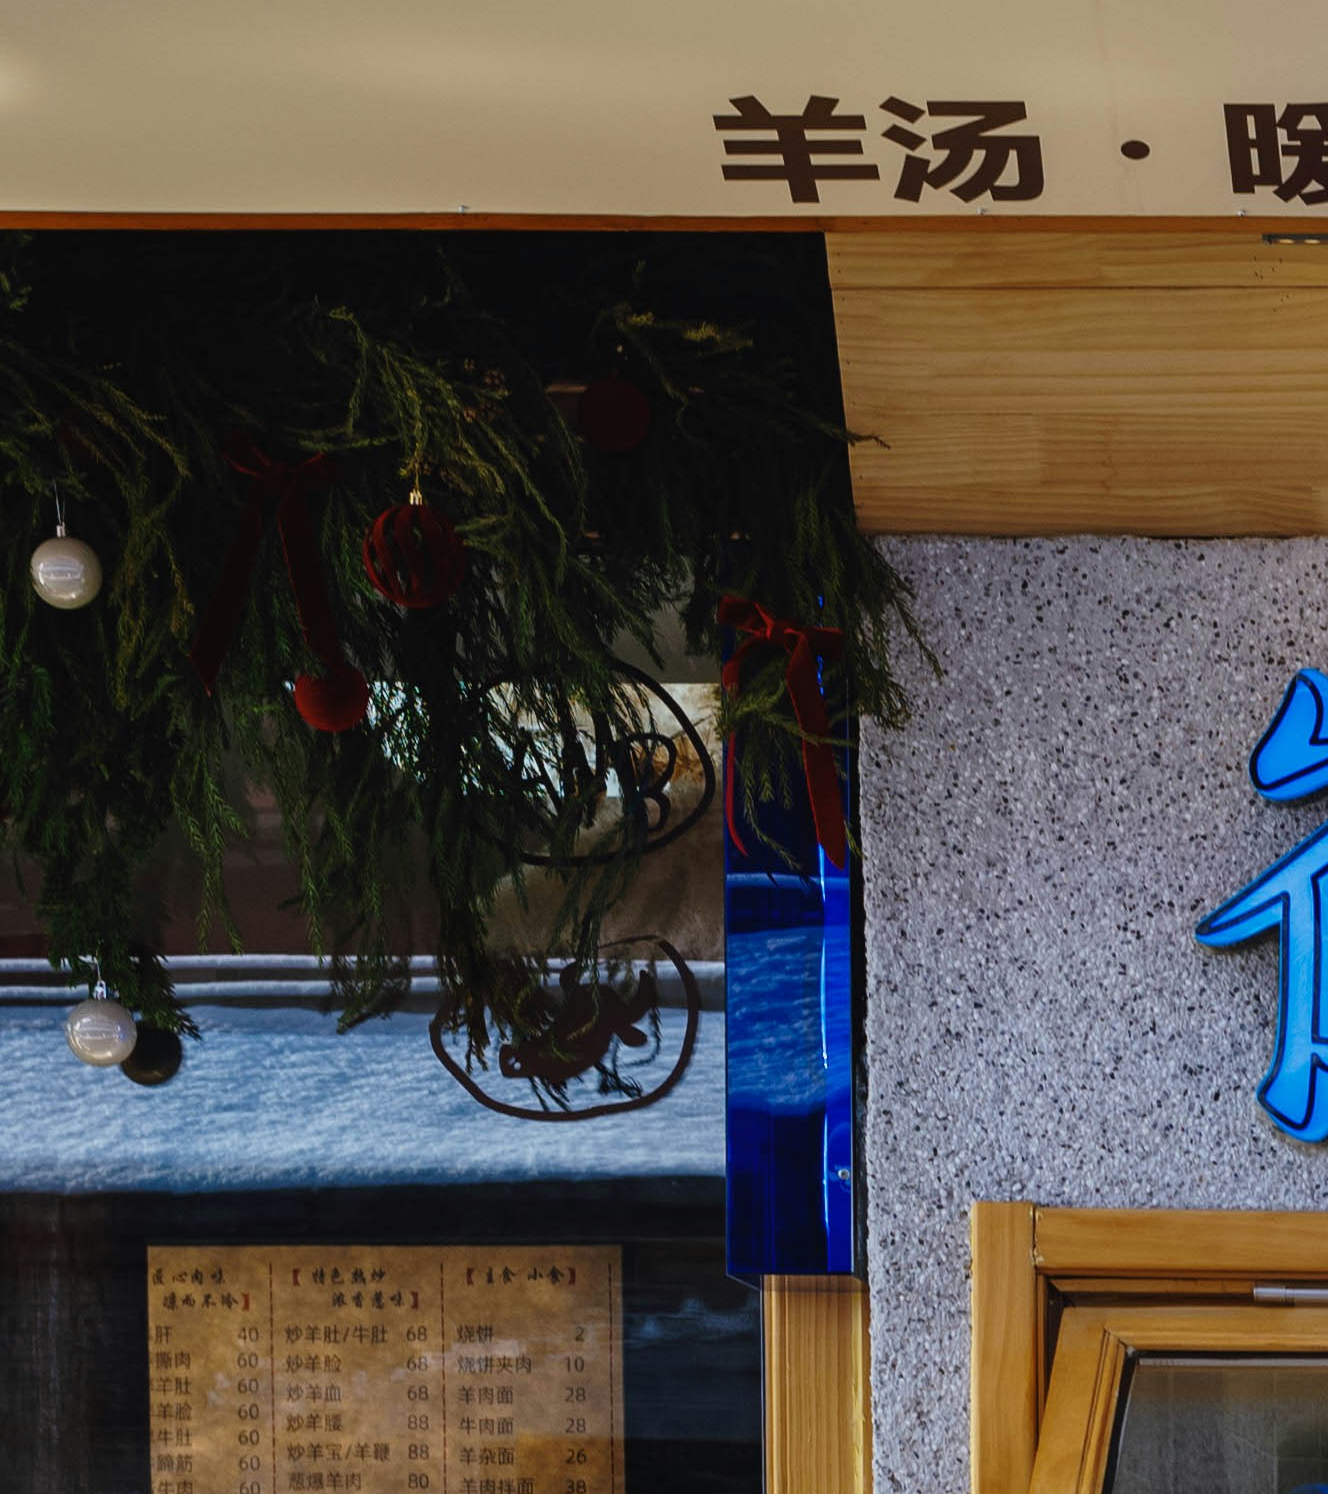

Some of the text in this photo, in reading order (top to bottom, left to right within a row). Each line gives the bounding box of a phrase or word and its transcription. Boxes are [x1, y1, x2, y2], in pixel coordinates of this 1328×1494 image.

[712, 94, 1045, 204] 羊汤
[237, 1327, 259, 1342] 40
[406, 1326, 428, 1342] 68
[574, 1327, 585, 1342] 2
[237, 1353, 259, 1368] 60
[407, 1355, 428, 1371] 68
[566, 1357, 585, 1372] 10
[237, 1379, 259, 1394] 60
[407, 1385, 429, 1401] 68
[565, 1387, 586, 1403] 28
[238, 1404, 259, 1419] 60
[407, 1414, 429, 1430] 88
[565, 1418, 586, 1433] 28
[238, 1429, 260, 1445] 60
[408, 1444, 430, 1460] 88
[565, 1449, 587, 1465] 26
[238, 1455, 260, 1471] 60
[408, 1473, 430, 1489] 80
[565, 1480, 586, 1494] 38
